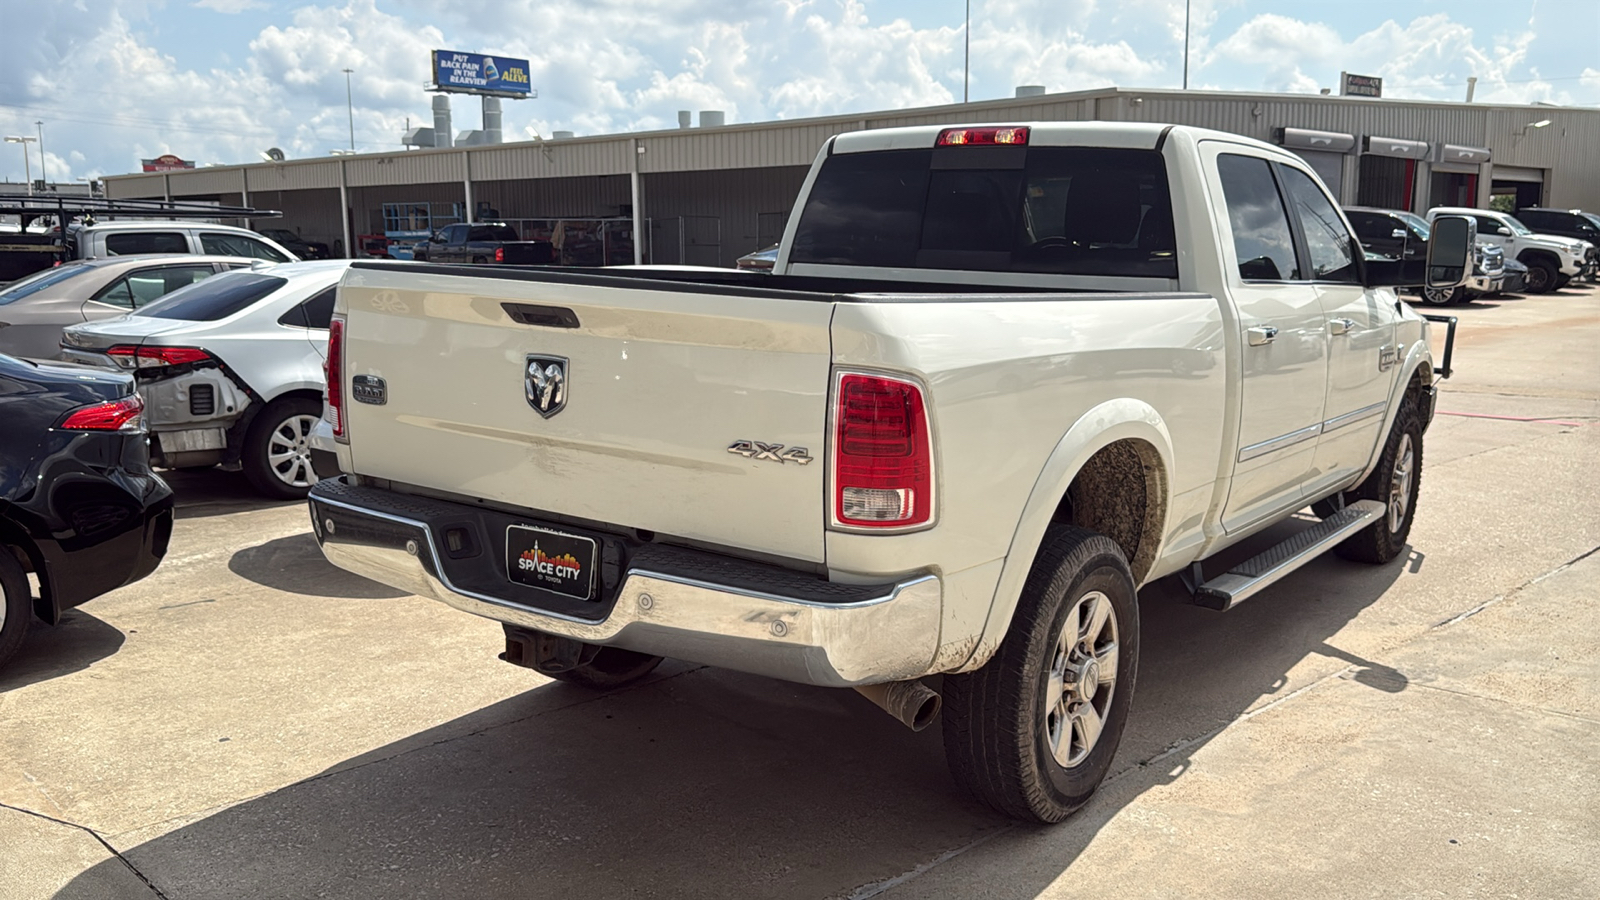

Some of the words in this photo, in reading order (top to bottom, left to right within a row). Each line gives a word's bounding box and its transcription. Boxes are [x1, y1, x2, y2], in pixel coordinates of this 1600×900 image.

[453, 54, 469, 62] PUT
[441, 60, 461, 69] BACK
[462, 62, 480, 71] PAIN
[463, 70, 477, 78] THE
[510, 67, 523, 76] FEEL
[450, 75, 487, 86] REARVIEW
[354, 384, 384, 398] RAM
[518, 556, 554, 575] SPACE
[555, 565, 580, 580] CITY
[545, 575, 562, 584] TOYOTA
